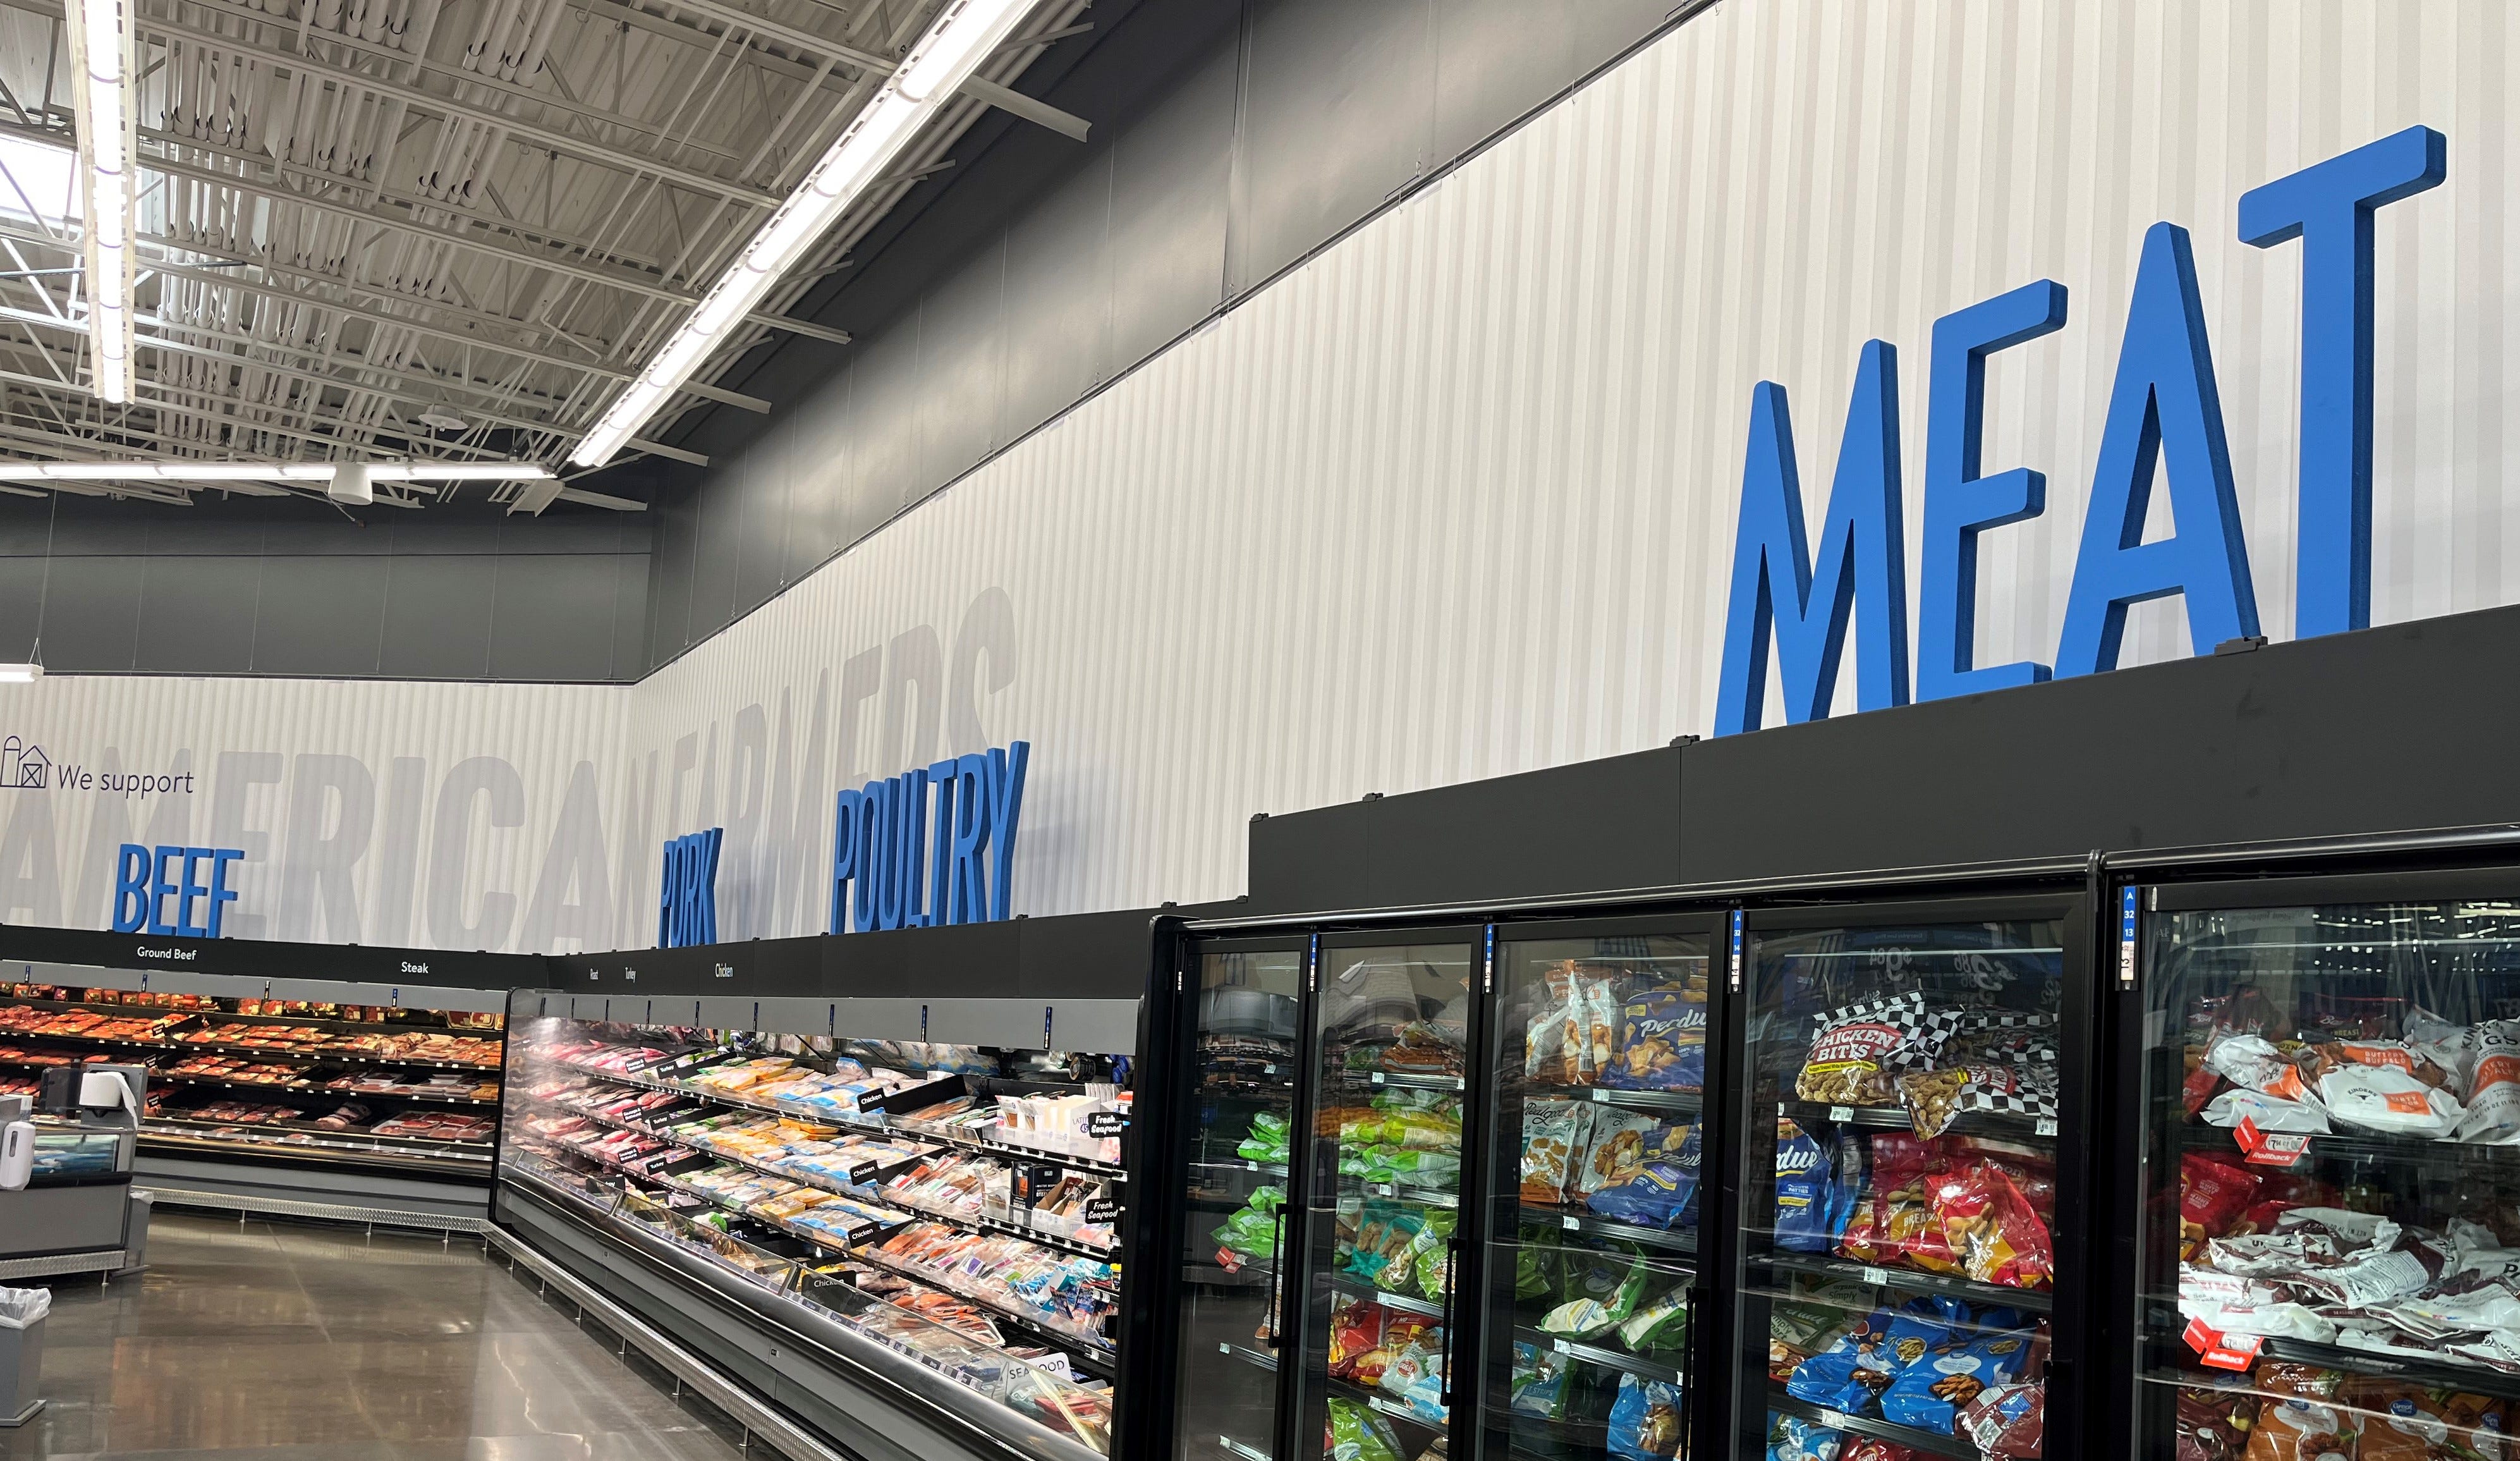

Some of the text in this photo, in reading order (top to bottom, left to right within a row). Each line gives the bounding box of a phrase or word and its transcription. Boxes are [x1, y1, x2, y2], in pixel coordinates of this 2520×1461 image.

[1713, 125, 2447, 738] MEAT
[59, 764, 194, 799] We support
[831, 741, 1030, 935] POULTRY
[111, 843, 245, 939] BEEF
[659, 827, 723, 949] PORK
[2126, 891, 2134, 900] A
[2124, 910, 2134, 919] 32
[2124, 928, 2134, 937] 13
[137, 945, 197, 962] Ground Beef
[401, 962, 429, 974] Steak
[715, 963, 733, 977] Chicken
[1816, 1043, 1870, 1062] BITES
[861, 1094, 882, 1104] Chicken
[1095, 1115, 1116, 1124] Fresh
[1091, 1124, 1121, 1135] Seafood
[2251, 1152, 2291, 1163] Rollback
[650, 1161, 664, 1169] Turkey
[853, 1165, 875, 1177] Chicken
[1093, 1201, 1113, 1210] Fresh
[1088, 1210, 1118, 1222] Seafood
[851, 1227, 873, 1240] Chicken
[813, 1278, 845, 1288] Chickn
[1829, 1292, 1858, 1300] Simply
[2207, 1352, 2245, 1366] Rollback
[1009, 1360, 1065, 1379] SEAOOD
[2392, 1402, 2413, 1411] Great
